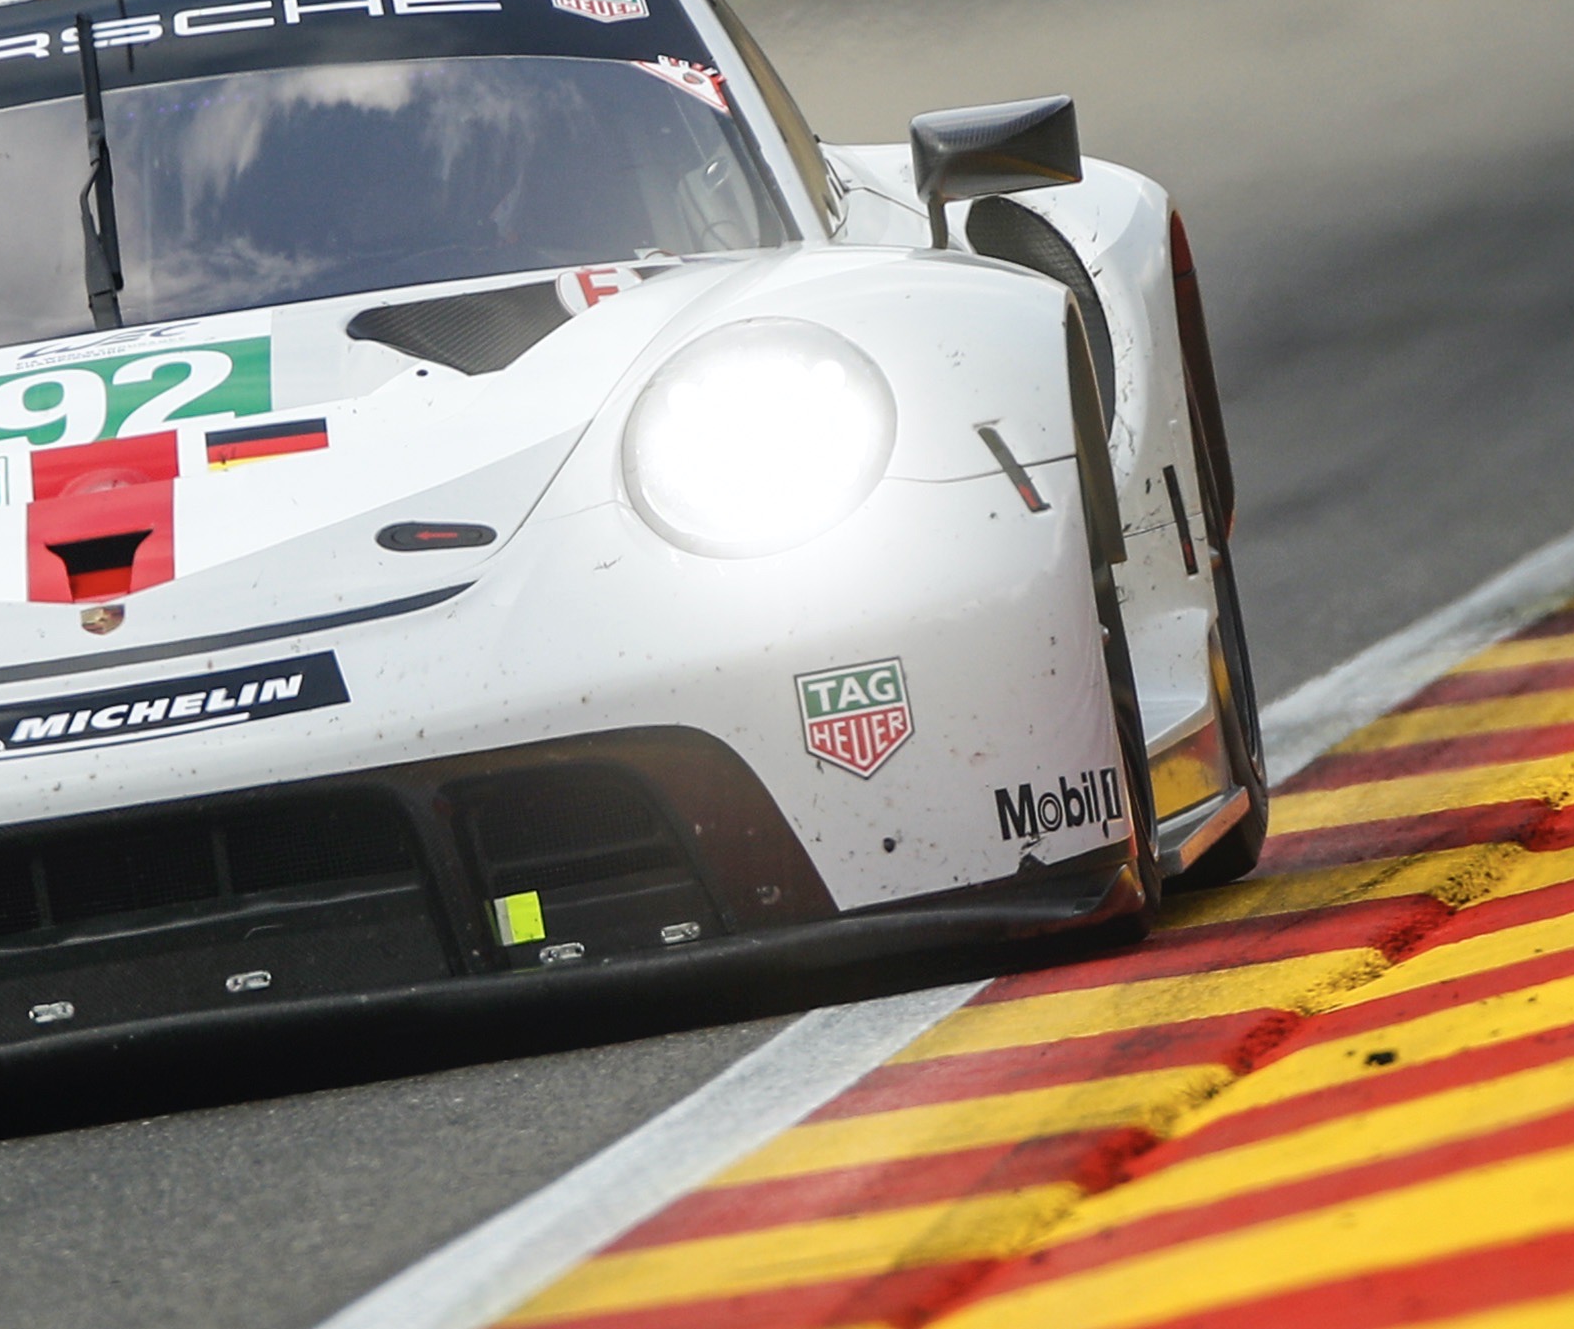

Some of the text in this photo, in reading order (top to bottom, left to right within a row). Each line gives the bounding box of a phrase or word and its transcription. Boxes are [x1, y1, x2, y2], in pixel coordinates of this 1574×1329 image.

[10, 674, 304, 743] MICHELIN
[807, 669, 898, 713] TAG
[811, 710, 905, 767] HEUER
[994, 770, 1101, 842] Mobil
